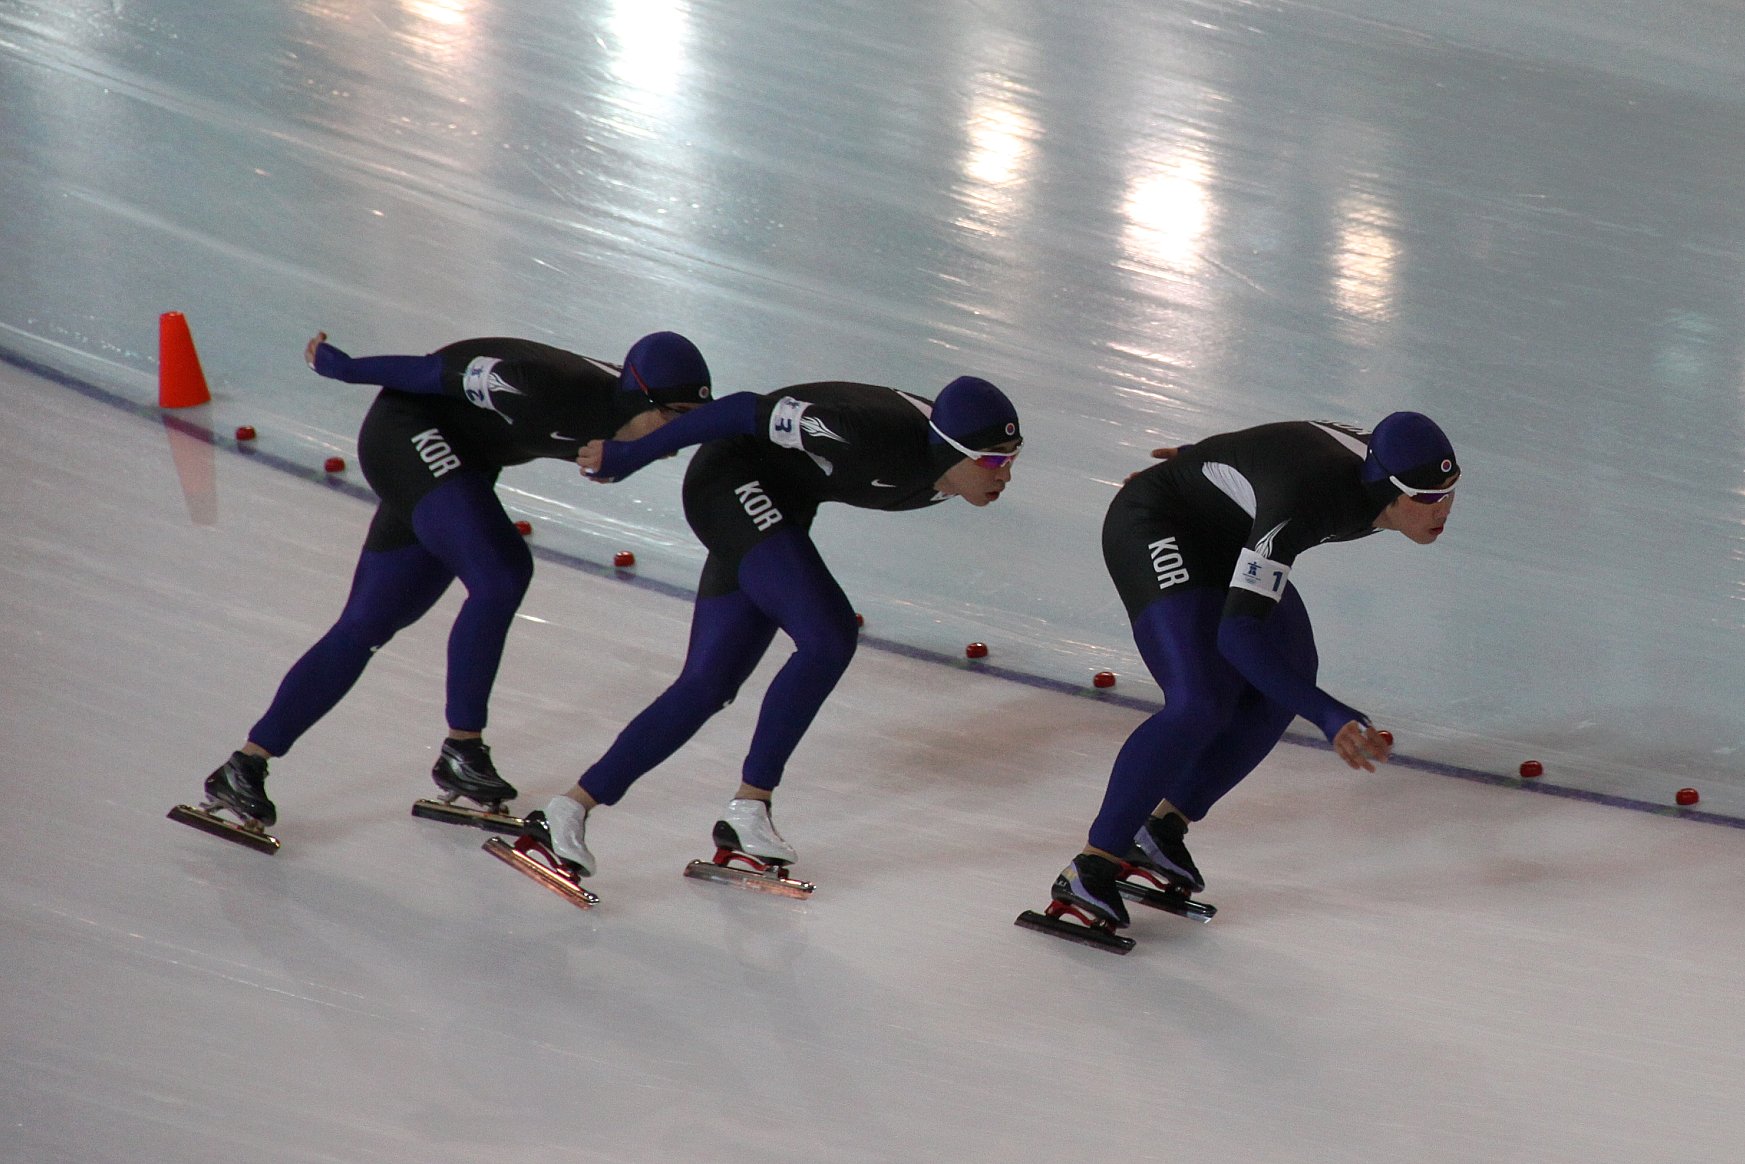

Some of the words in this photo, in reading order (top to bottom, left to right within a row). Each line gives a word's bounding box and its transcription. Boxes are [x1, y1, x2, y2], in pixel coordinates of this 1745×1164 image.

[465, 389, 485, 402] 2
[775, 417, 792, 433] 3
[411, 428, 461, 478] KOR
[734, 480, 783, 532] KOR
[1148, 536, 1190, 590] KOR
[1272, 571, 1283, 592] 1
